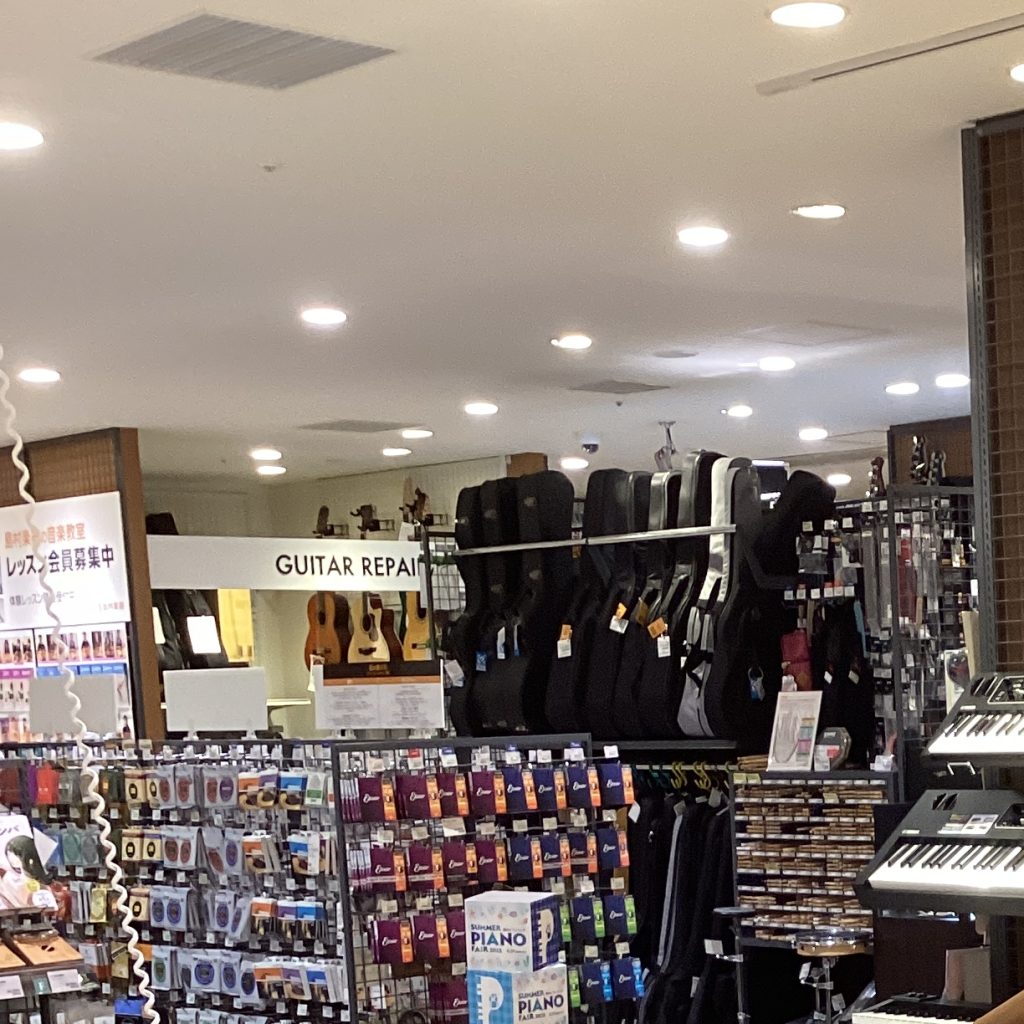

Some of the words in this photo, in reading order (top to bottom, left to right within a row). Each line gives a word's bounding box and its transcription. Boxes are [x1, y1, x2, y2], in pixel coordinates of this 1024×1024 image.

[275, 554, 355, 576] GUITAR
[362, 556, 421, 577] REPAI
[470, 931, 527, 946] PIANO
[518, 995, 564, 1014] PIANO
